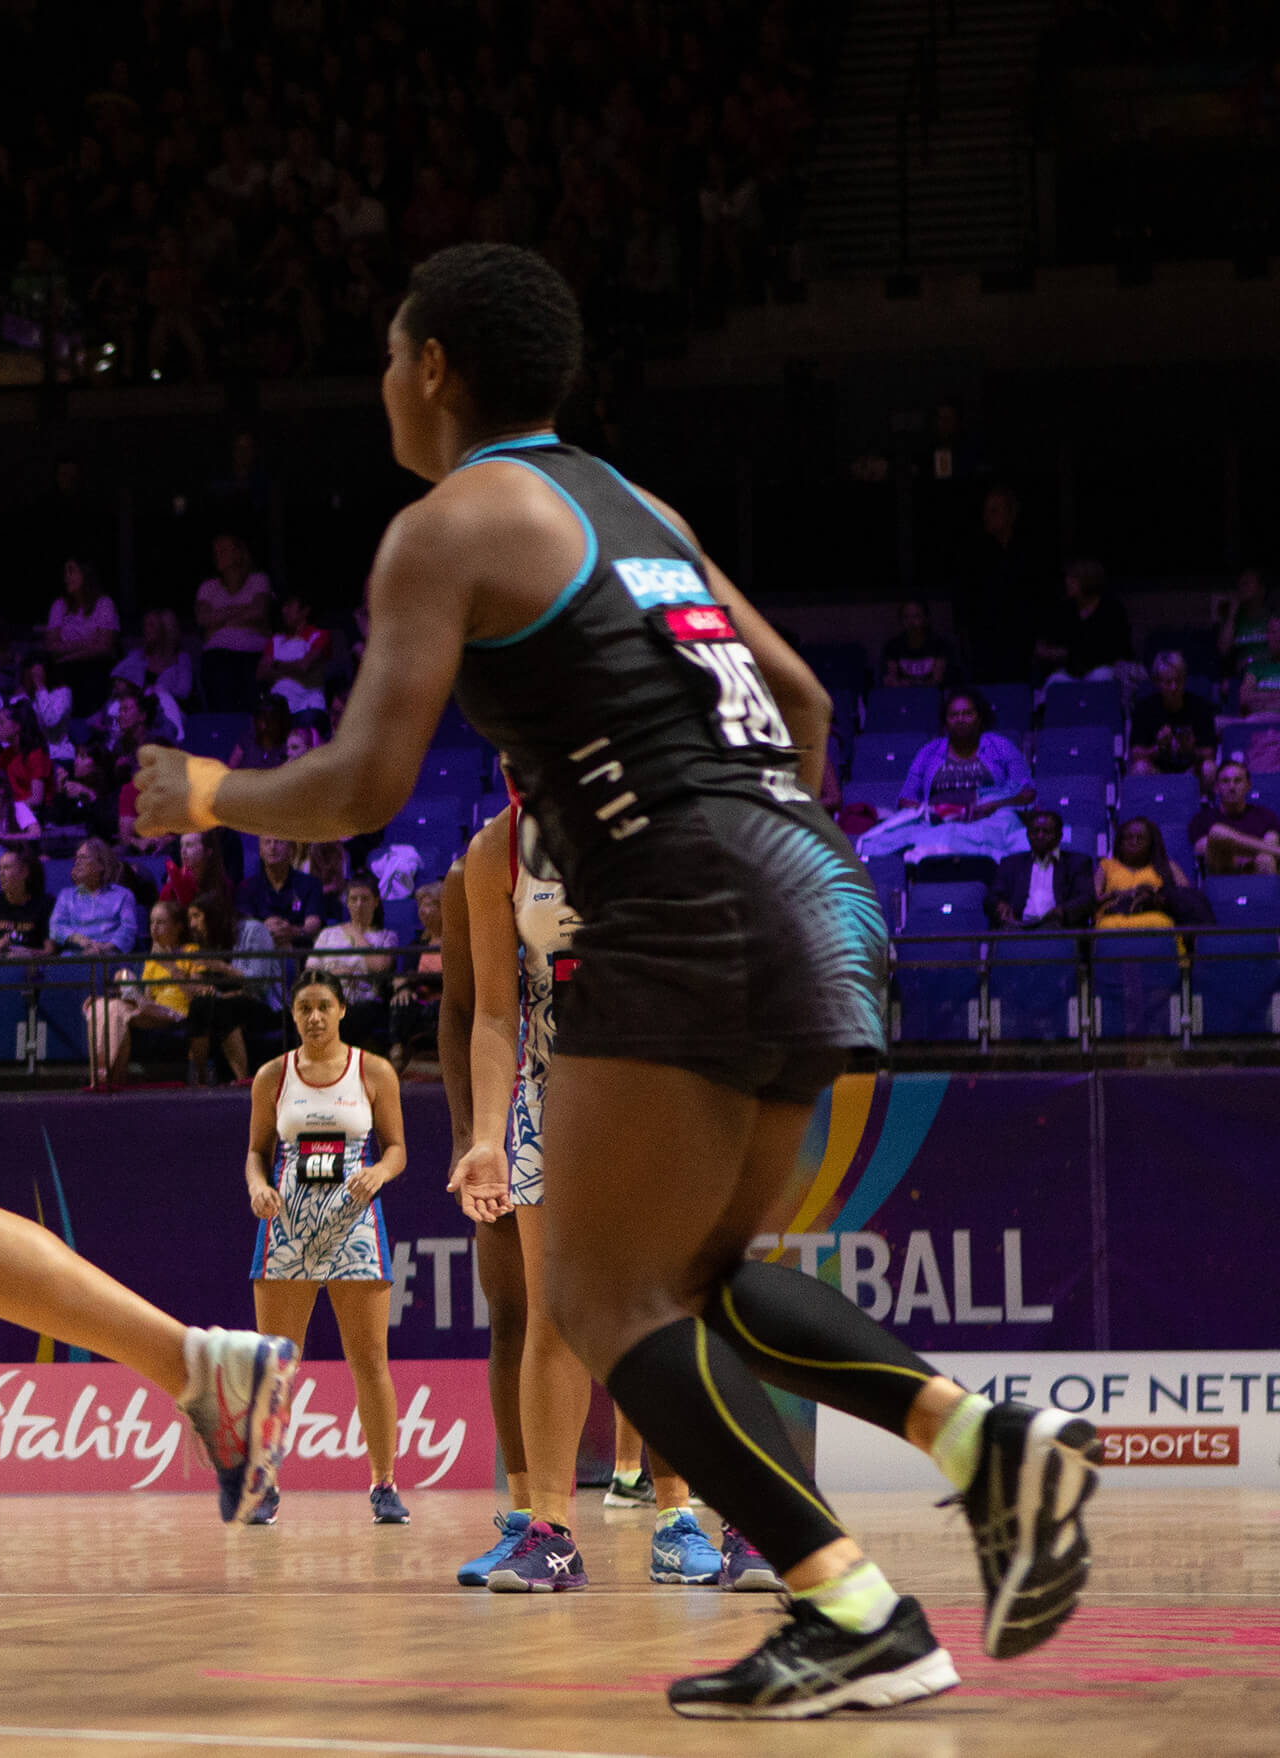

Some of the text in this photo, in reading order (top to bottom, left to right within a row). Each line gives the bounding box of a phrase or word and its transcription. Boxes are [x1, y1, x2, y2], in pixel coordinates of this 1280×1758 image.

[306, 1153, 336, 1179] GK
[1049, 1373, 1129, 1414] OF
[283, 1377, 467, 1489] talty
[1103, 1429, 1232, 1464] sports
